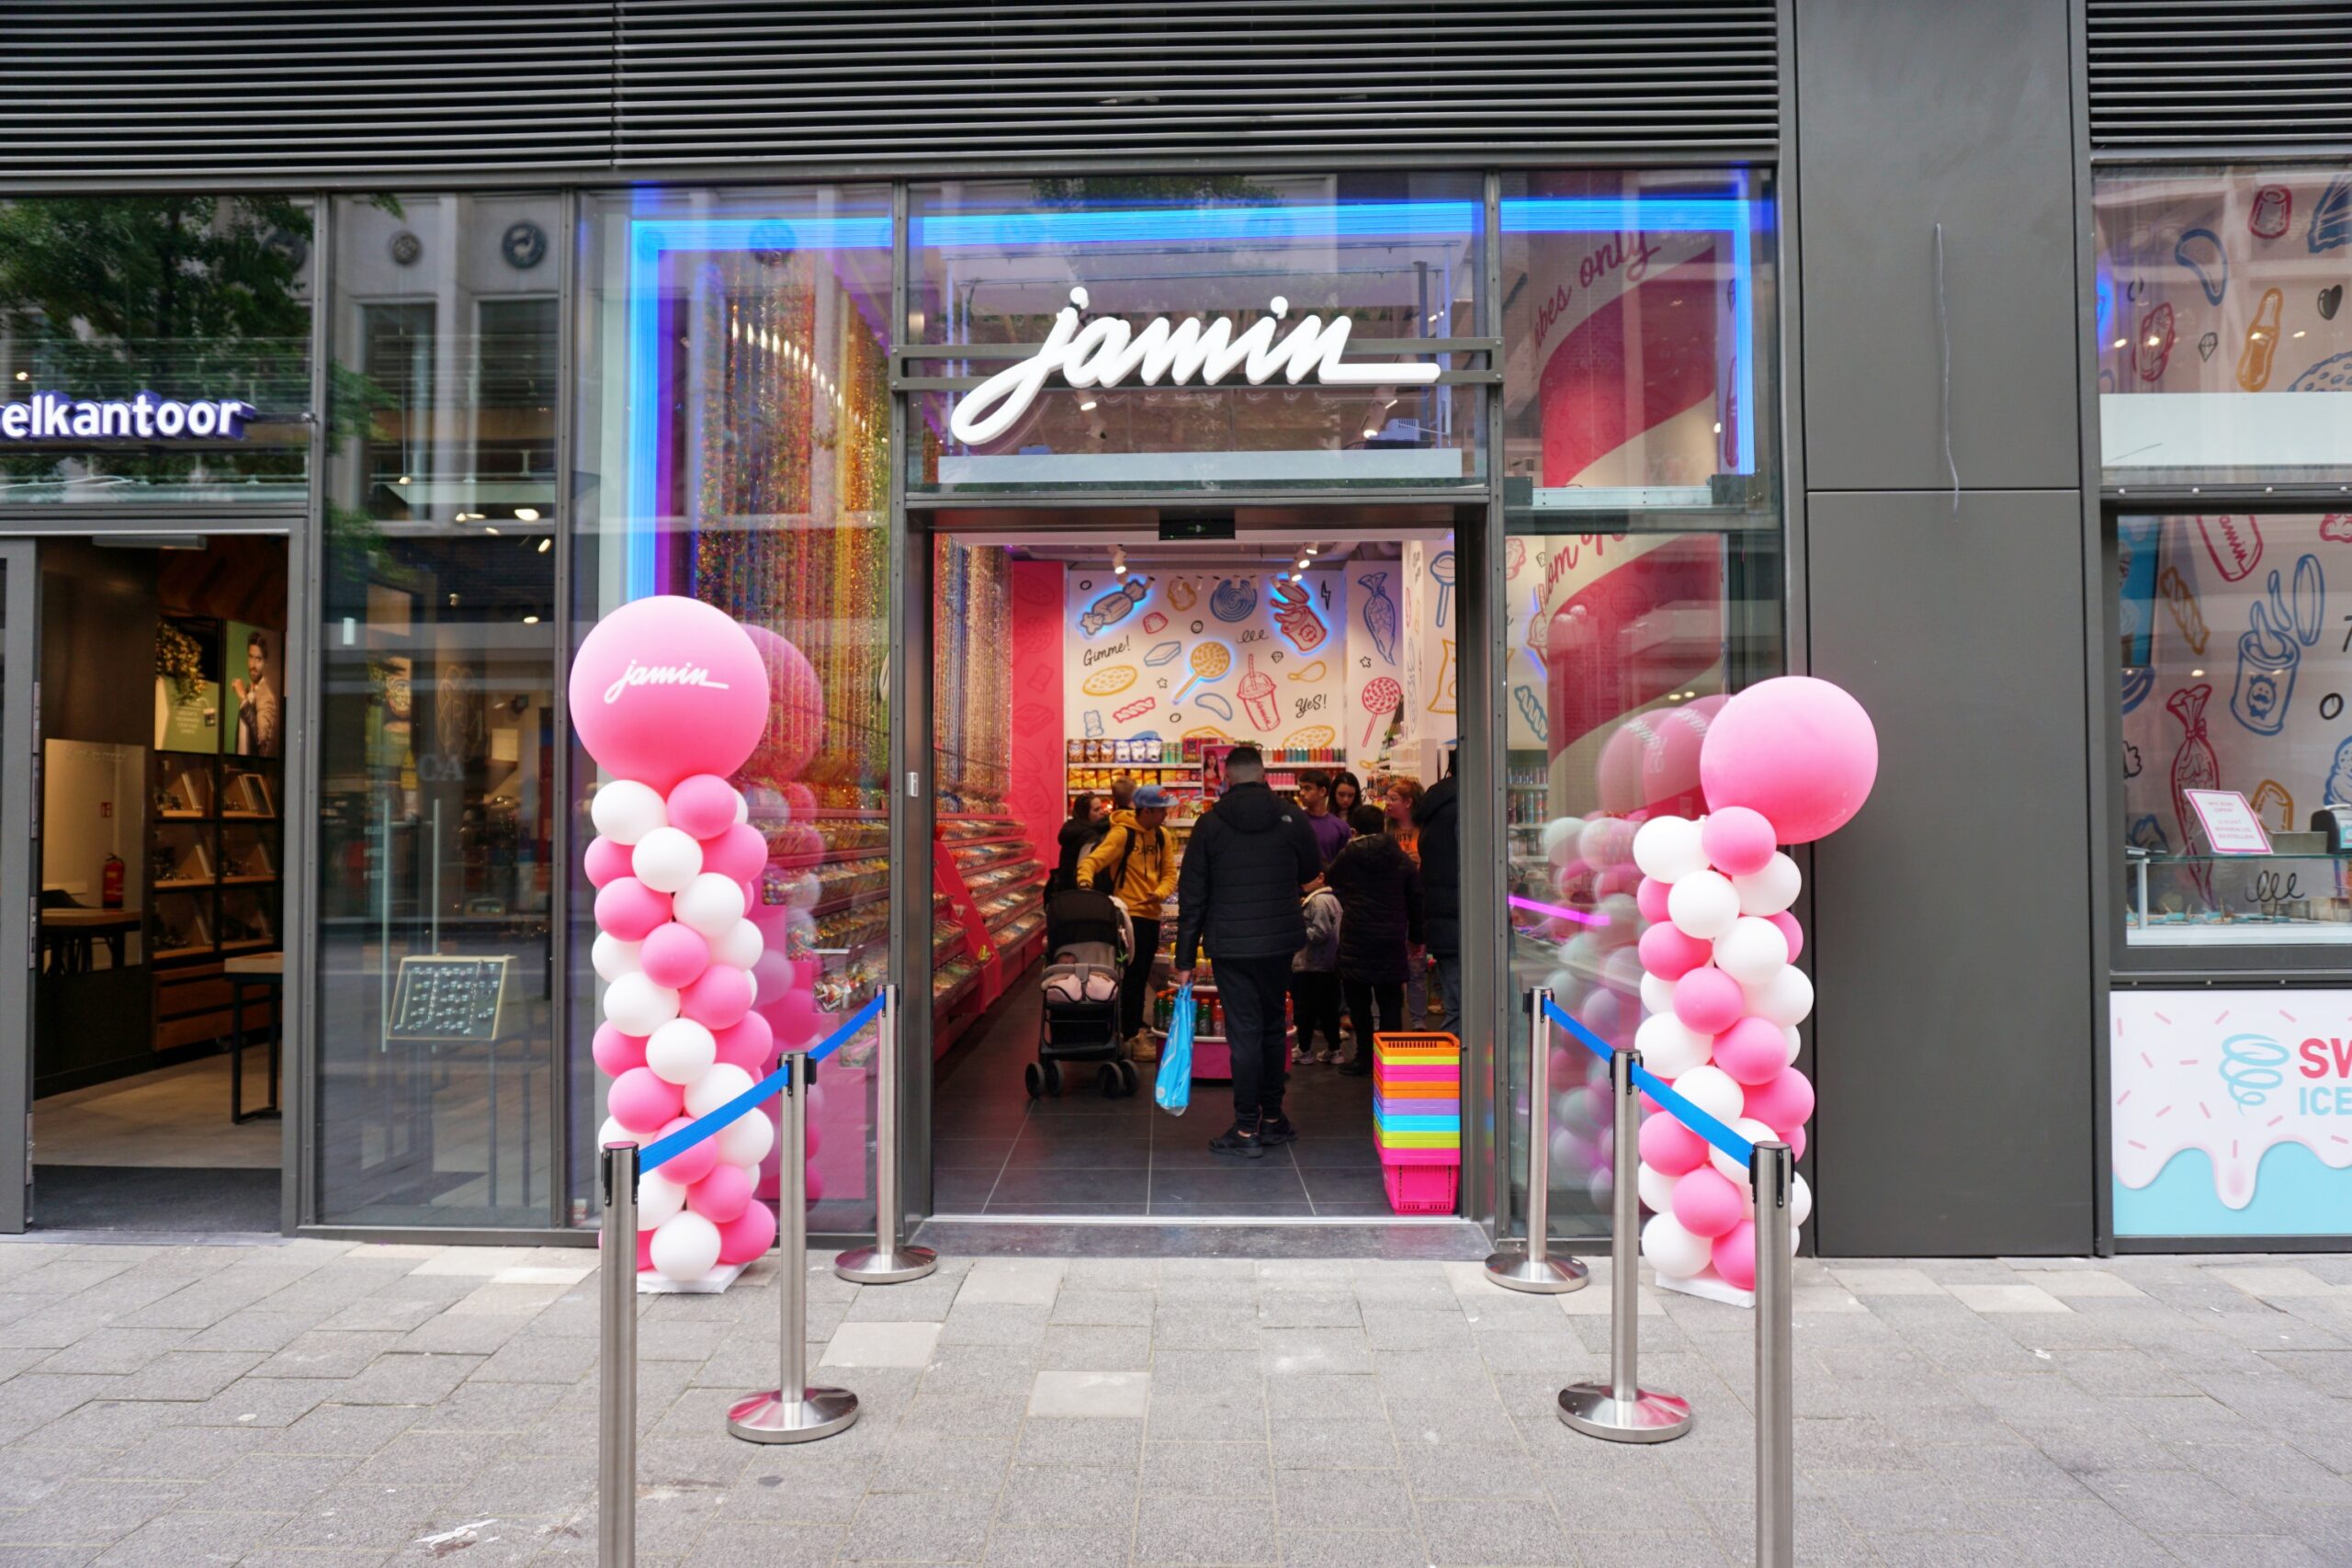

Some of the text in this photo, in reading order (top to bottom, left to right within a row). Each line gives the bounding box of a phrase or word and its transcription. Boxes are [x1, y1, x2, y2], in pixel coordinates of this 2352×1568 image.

[950, 286, 1441, 446] jamin
[1, 394, 242, 438] elkantoor
[1084, 635, 1130, 667] Gimme!
[604, 659, 729, 705] jamin
[2299, 1087, 2352, 1115] ICE
